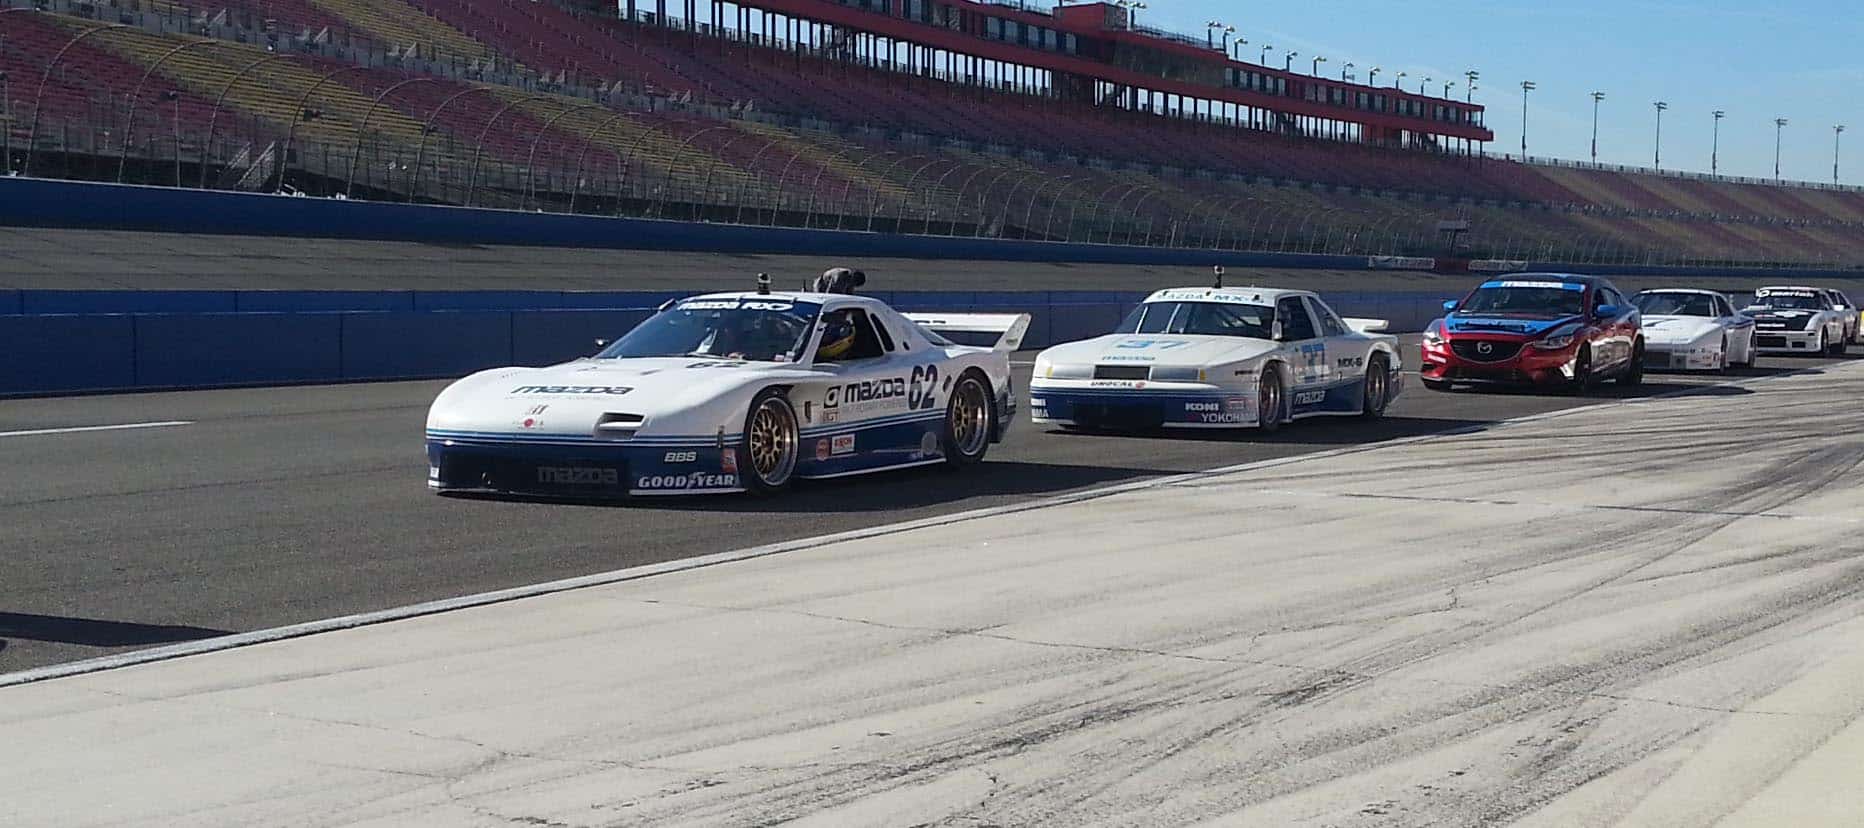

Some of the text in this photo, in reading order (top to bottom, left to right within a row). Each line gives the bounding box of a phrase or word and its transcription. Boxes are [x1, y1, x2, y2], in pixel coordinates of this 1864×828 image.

[510, 386, 634, 394] mazda
[845, 378, 905, 402] mazda
[909, 364, 938, 410] 62
[1185, 402, 1220, 411] KONI
[664, 452, 697, 462] BBS
[537, 467, 619, 484] mazda
[638, 472, 735, 488] GOODYEAR
